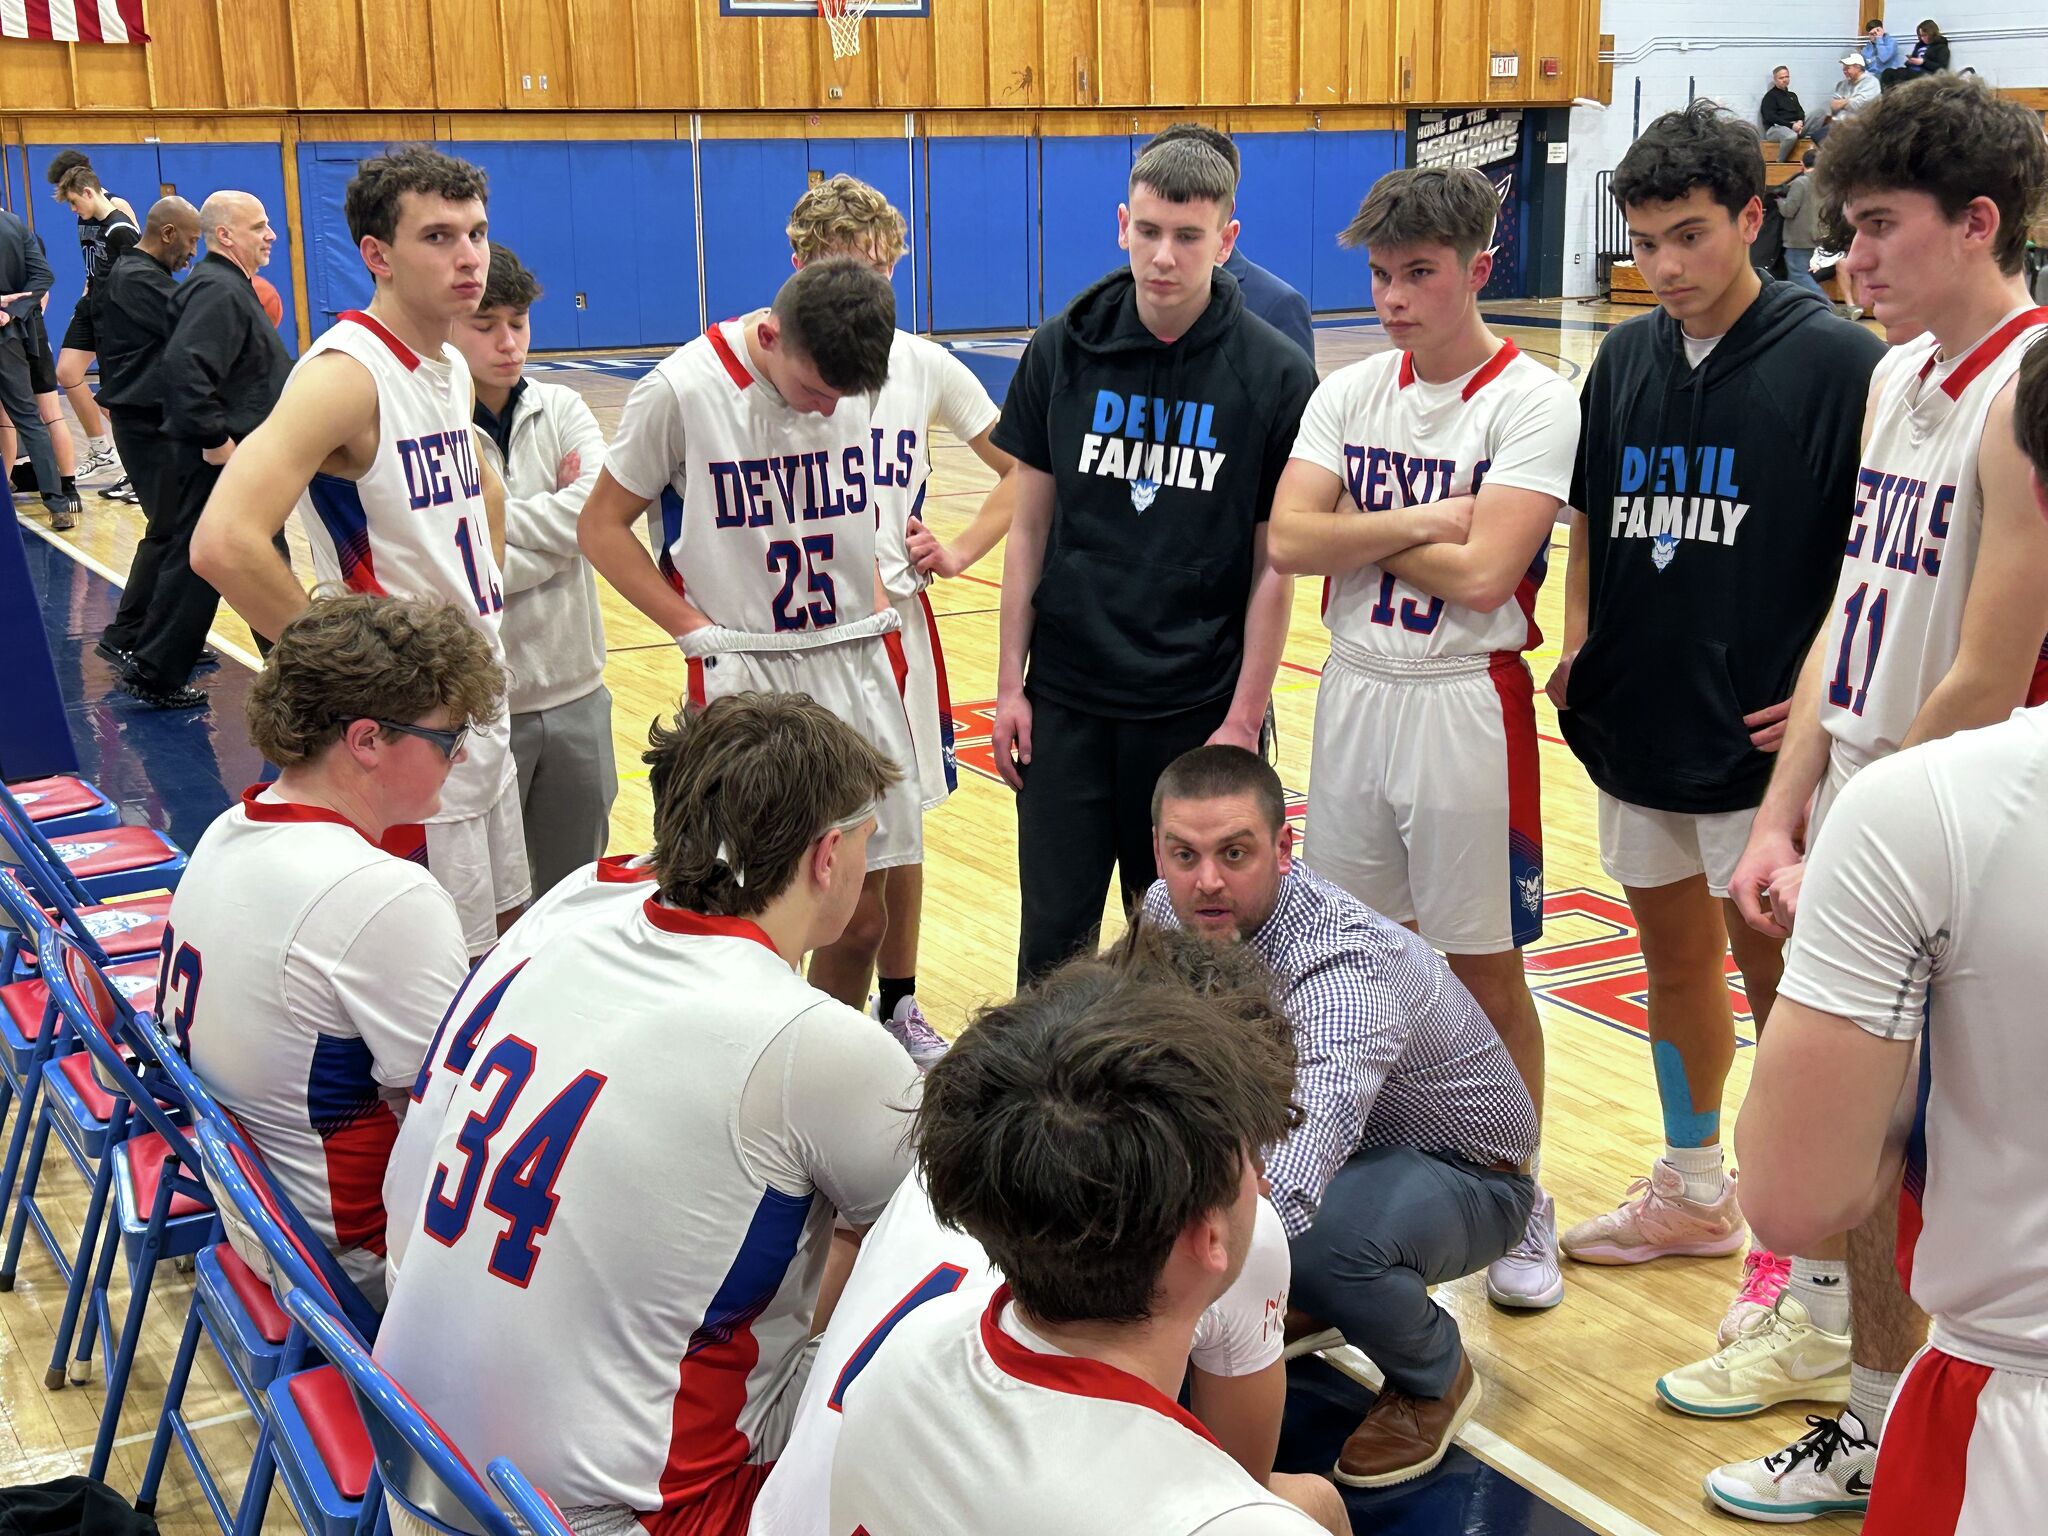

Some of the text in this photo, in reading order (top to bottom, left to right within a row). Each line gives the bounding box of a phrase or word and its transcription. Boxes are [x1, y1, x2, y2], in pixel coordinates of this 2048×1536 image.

[1497, 58, 1515, 74] EXIT
[1417, 108, 1488, 140] HOME OF THE
[1092, 389, 1218, 449] DEVIL
[708, 445, 868, 529] DEVILS
[1078, 433, 1226, 492] FAMILY
[1620, 446, 1740, 498] DEVIL
[1610, 496, 1750, 547] FAMILY
[766, 533, 837, 632] 25
[1829, 582, 1888, 717] 11
[424, 1033, 608, 1290] 34
